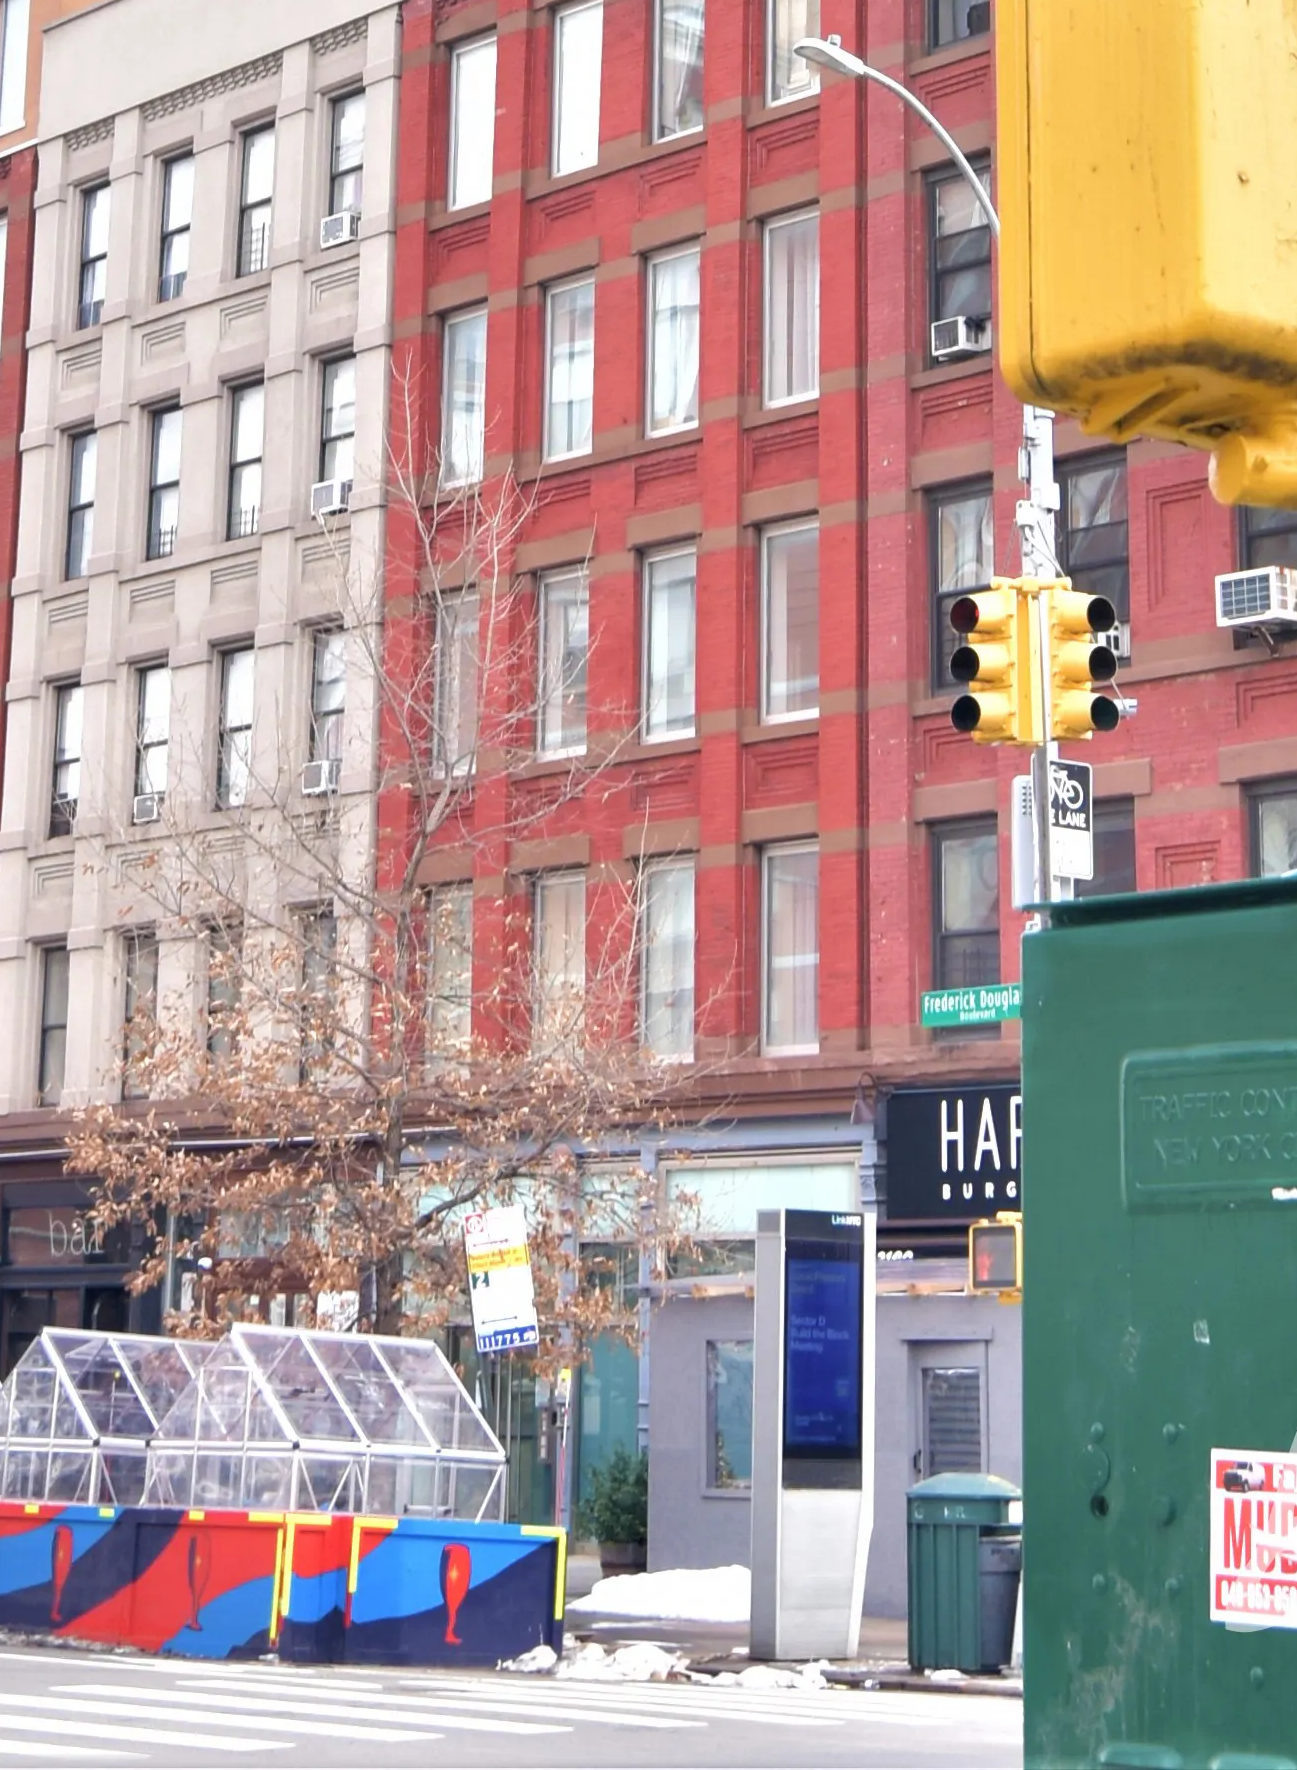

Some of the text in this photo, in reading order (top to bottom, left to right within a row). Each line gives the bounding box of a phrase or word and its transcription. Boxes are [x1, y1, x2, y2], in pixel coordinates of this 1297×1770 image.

[1058, 809, 1087, 828] LANE
[924, 986, 1022, 1013] Frederick Dougla
[959, 1008, 997, 1022] Boulevard
[1139, 1089, 1231, 1121] TRAFFIC
[1153, 1135, 1201, 1169] NEW
[1211, 1133, 1272, 1162] YORK
[941, 1180, 1018, 1201] BURG
